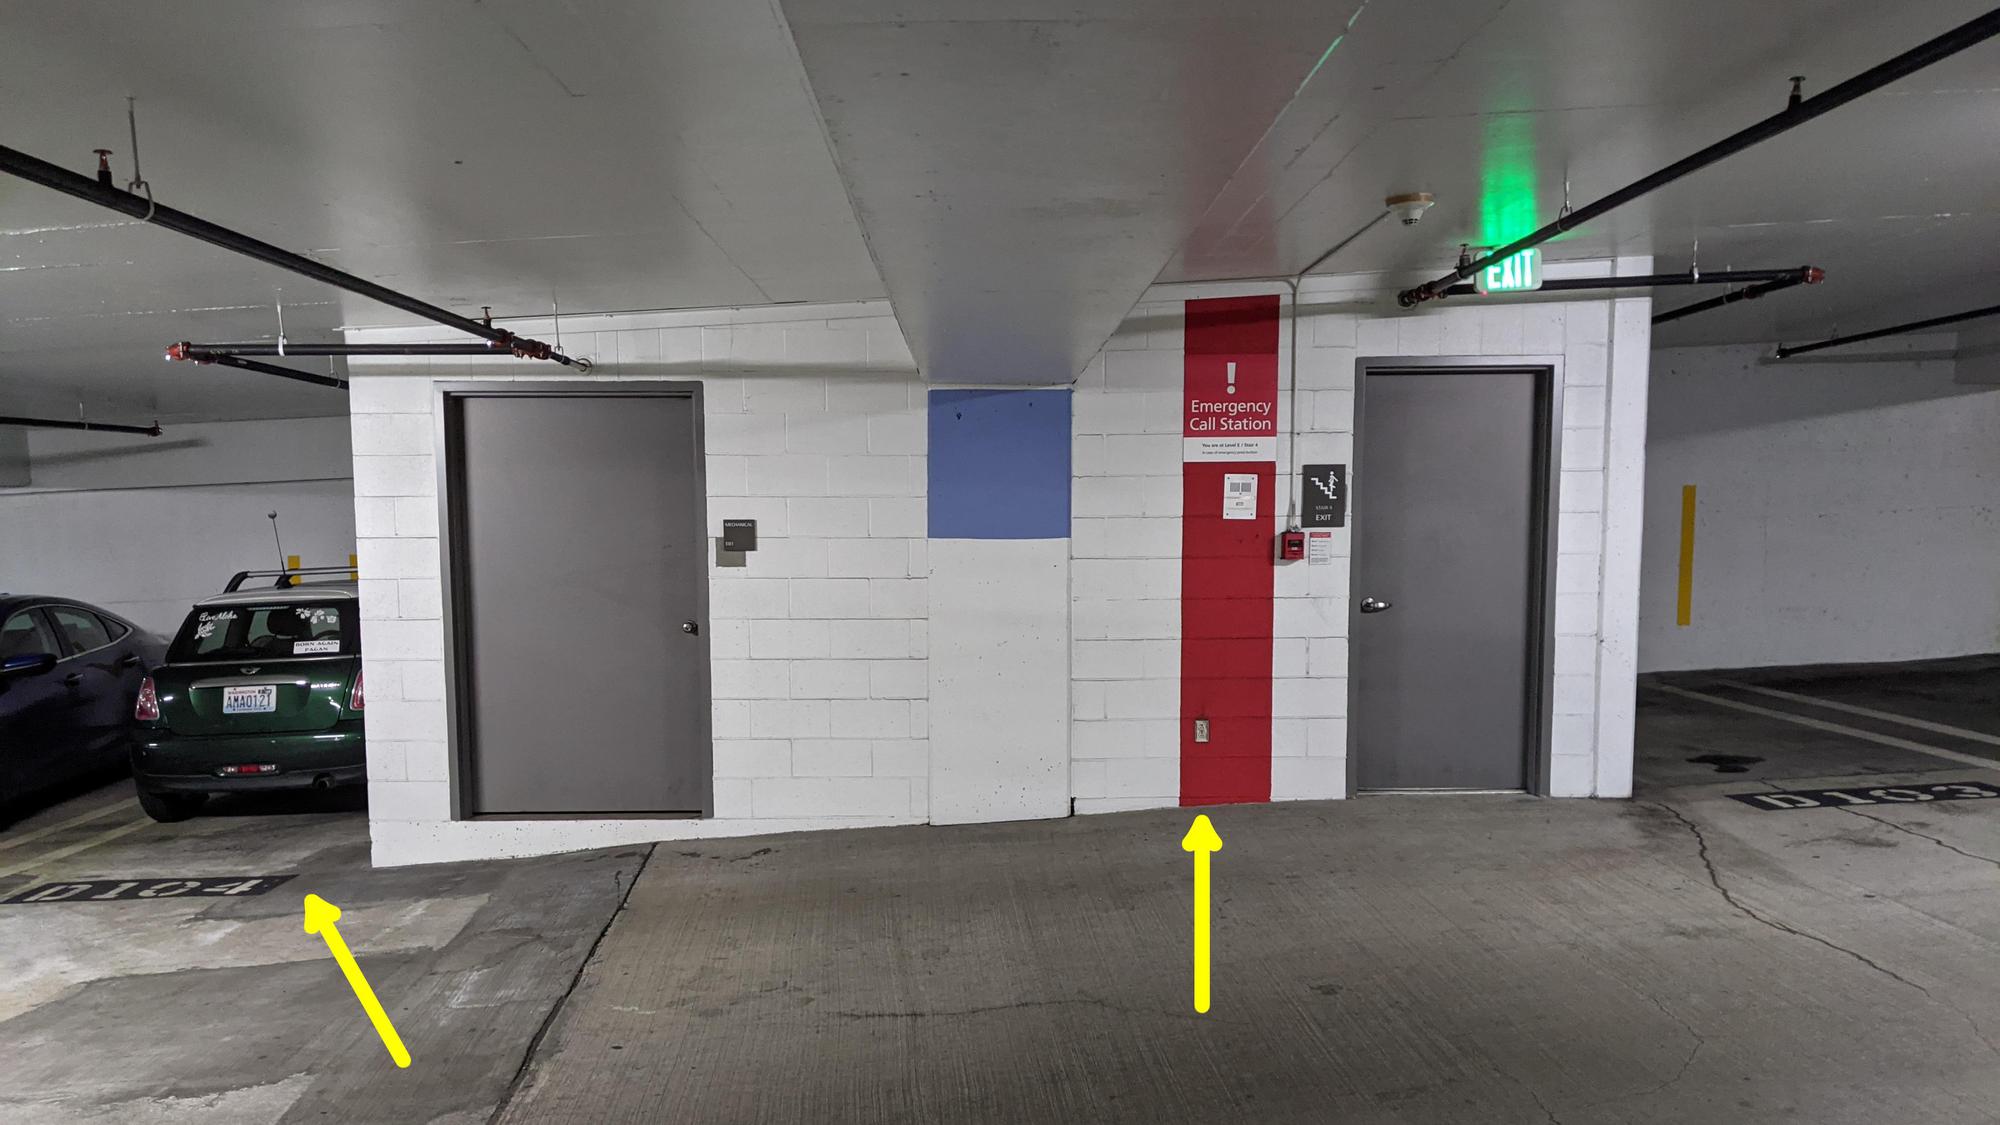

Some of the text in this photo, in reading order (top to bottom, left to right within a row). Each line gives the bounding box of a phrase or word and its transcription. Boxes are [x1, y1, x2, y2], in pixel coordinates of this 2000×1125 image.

[1487, 250, 1535, 288] EXIT
[1191, 400, 1271, 416] Emergency
[1190, 416, 1271, 431] Call Station
[22, 878, 264, 902] D104
